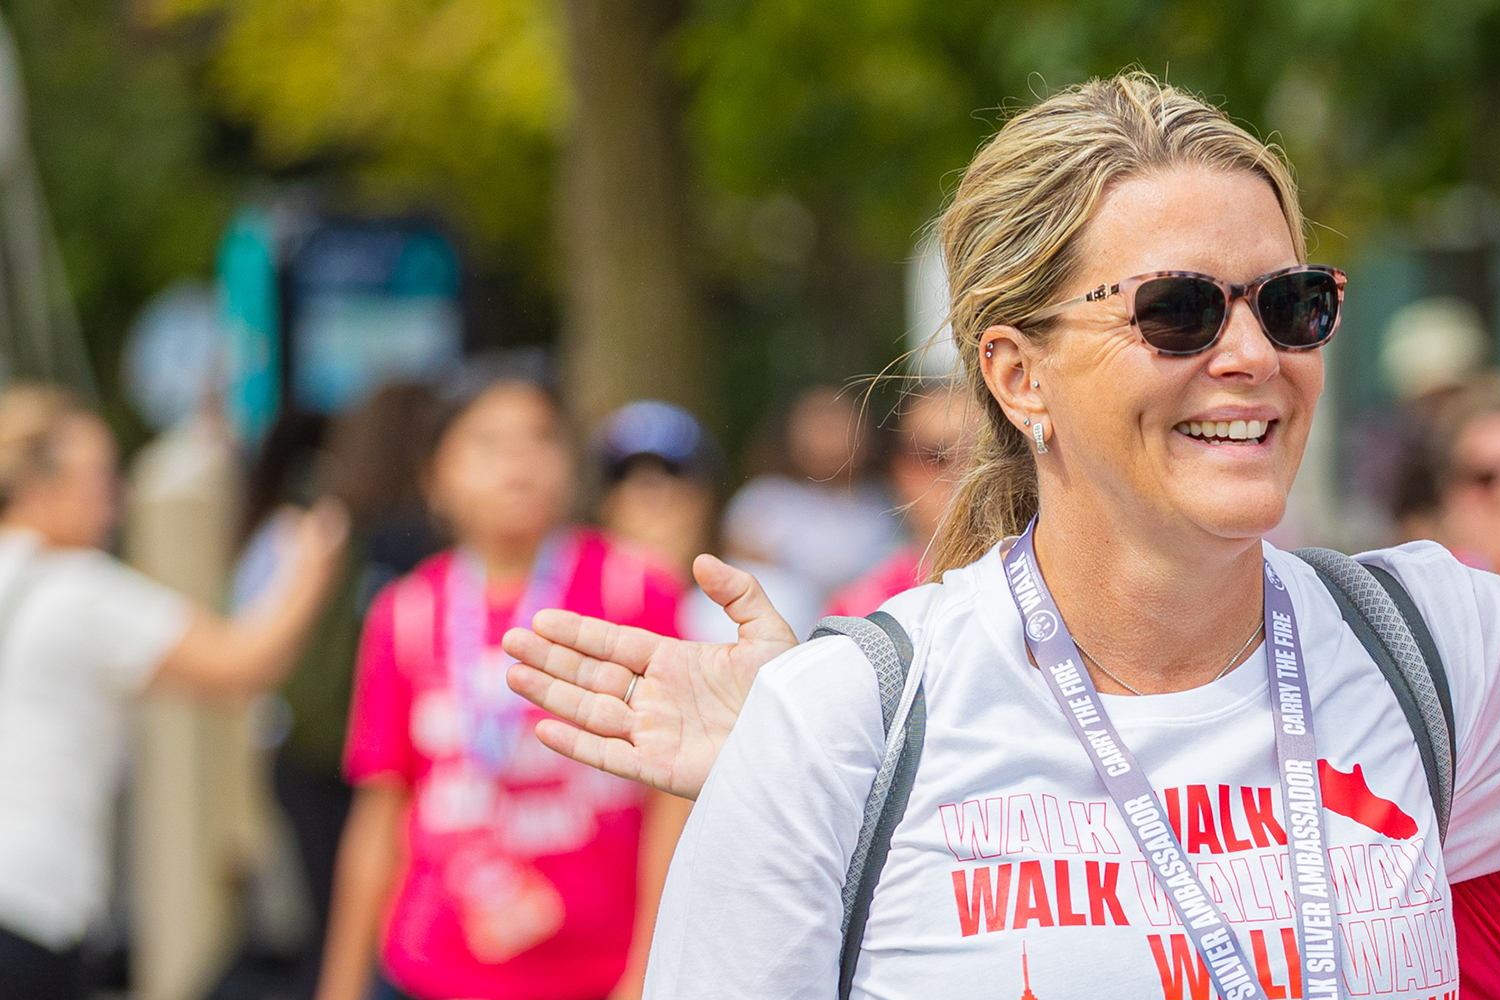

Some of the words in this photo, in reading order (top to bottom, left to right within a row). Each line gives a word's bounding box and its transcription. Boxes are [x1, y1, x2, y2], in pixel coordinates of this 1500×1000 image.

[1009, 551, 1041, 615] WALK
[1273, 611, 1295, 648] FIRE
[1050, 659, 1084, 695] FIRE
[1275, 648, 1298, 679] THE
[1068, 693, 1101, 728] THE
[1278, 681, 1306, 735] CARRY
[1086, 728, 1131, 778] CARRY
[939, 794, 1121, 861] WALK
[1285, 759, 1329, 898] AMBASSADOR
[951, 860, 1130, 937] WALK
[1327, 838, 1442, 915] WALK
[1124, 794, 1222, 930] AMBASSADOR
[1302, 901, 1336, 972] SILVER
[1338, 908, 1457, 996] WALK
